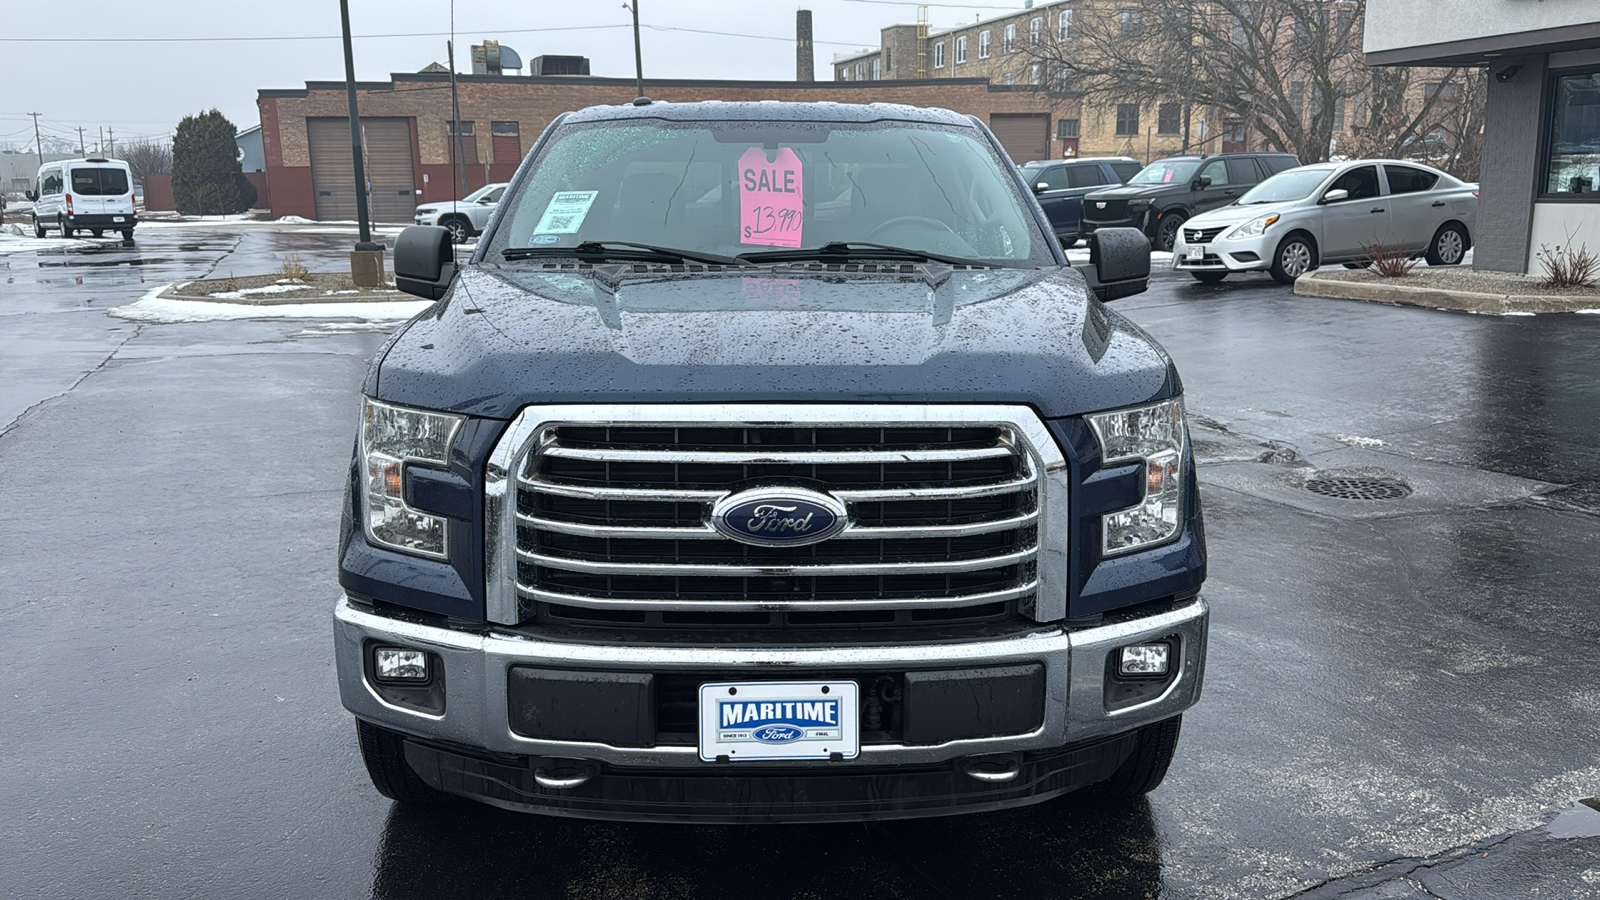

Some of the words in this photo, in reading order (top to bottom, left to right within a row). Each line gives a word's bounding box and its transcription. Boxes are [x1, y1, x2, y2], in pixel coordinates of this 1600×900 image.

[744, 168, 795, 193] SALE
[747, 504, 813, 532] Ford
[722, 702, 836, 727] MARITIME
[762, 728, 794, 740] Ford
